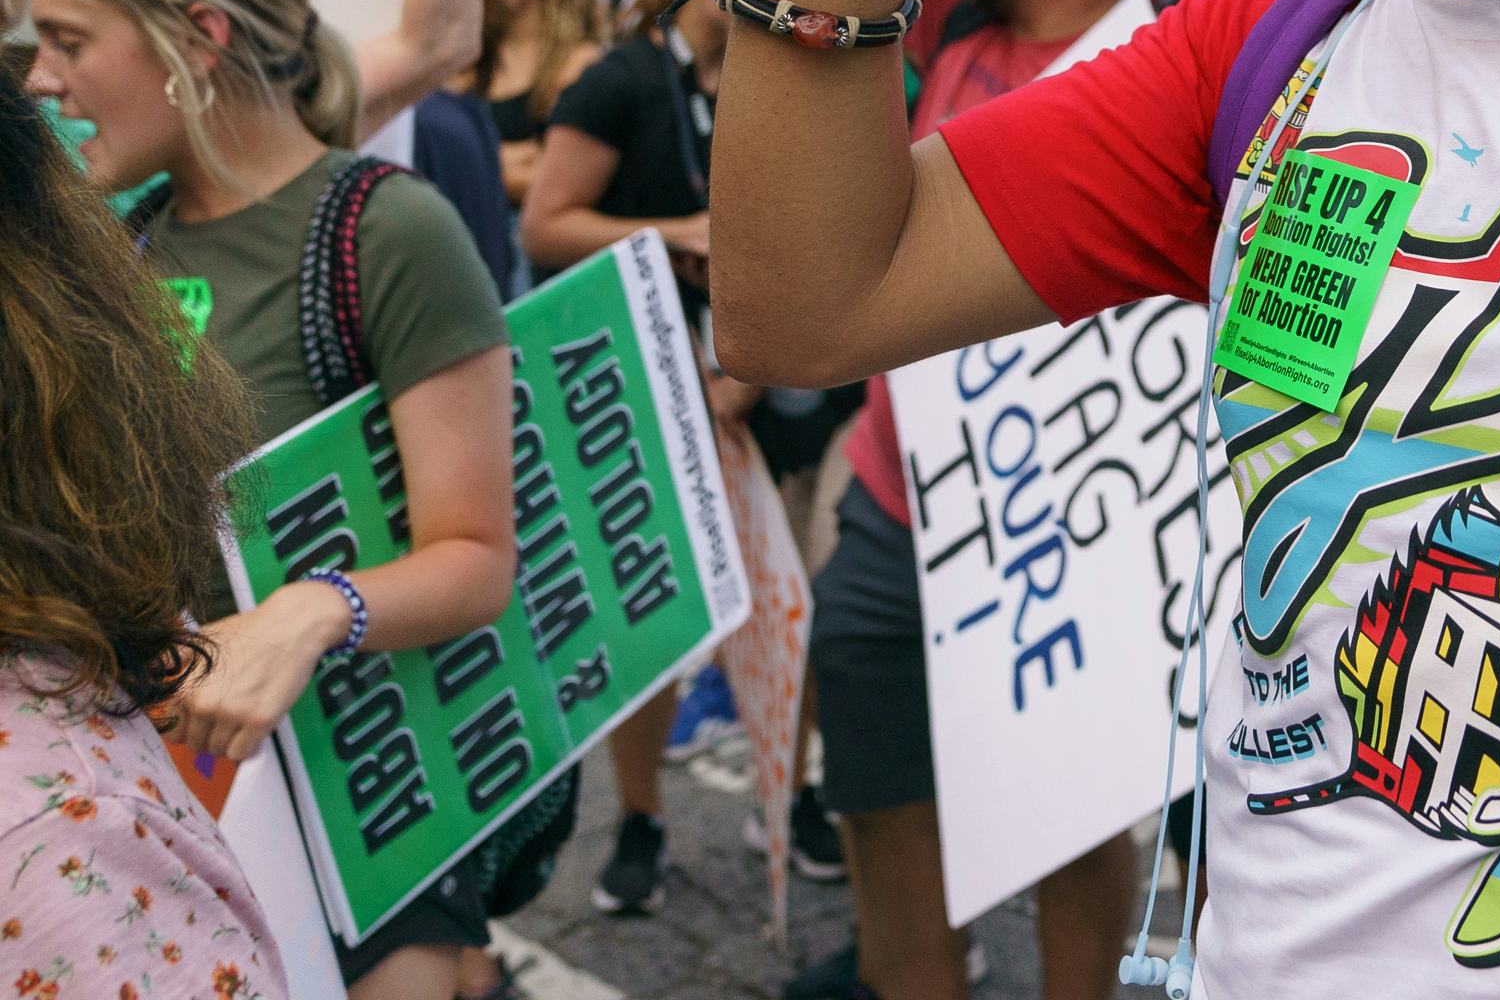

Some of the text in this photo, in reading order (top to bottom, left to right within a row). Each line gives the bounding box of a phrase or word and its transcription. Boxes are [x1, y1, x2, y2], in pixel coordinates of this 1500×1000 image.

[1272, 161, 1396, 235] RISE UP 4
[1262, 209, 1377, 267] Abortion Rights!
[1249, 246, 1357, 311] WEAR GREEN
[1237, 281, 1343, 348] for Abortion
[1234, 345, 1331, 394] RiseUp4AbortionRights.org
[1288, 354, 1335, 377] #Green4Abortion
[1030, 316, 1142, 548] TAG
[553, 327, 679, 627] APOLOGY
[508, 345, 612, 713] & WITHO
[910, 418, 1000, 645] IT!
[266, 473, 436, 856] ABORON
[1243, 653, 1309, 706] TO THE
[449, 687, 532, 814] ON
[1226, 713, 1327, 763] ULLEST
